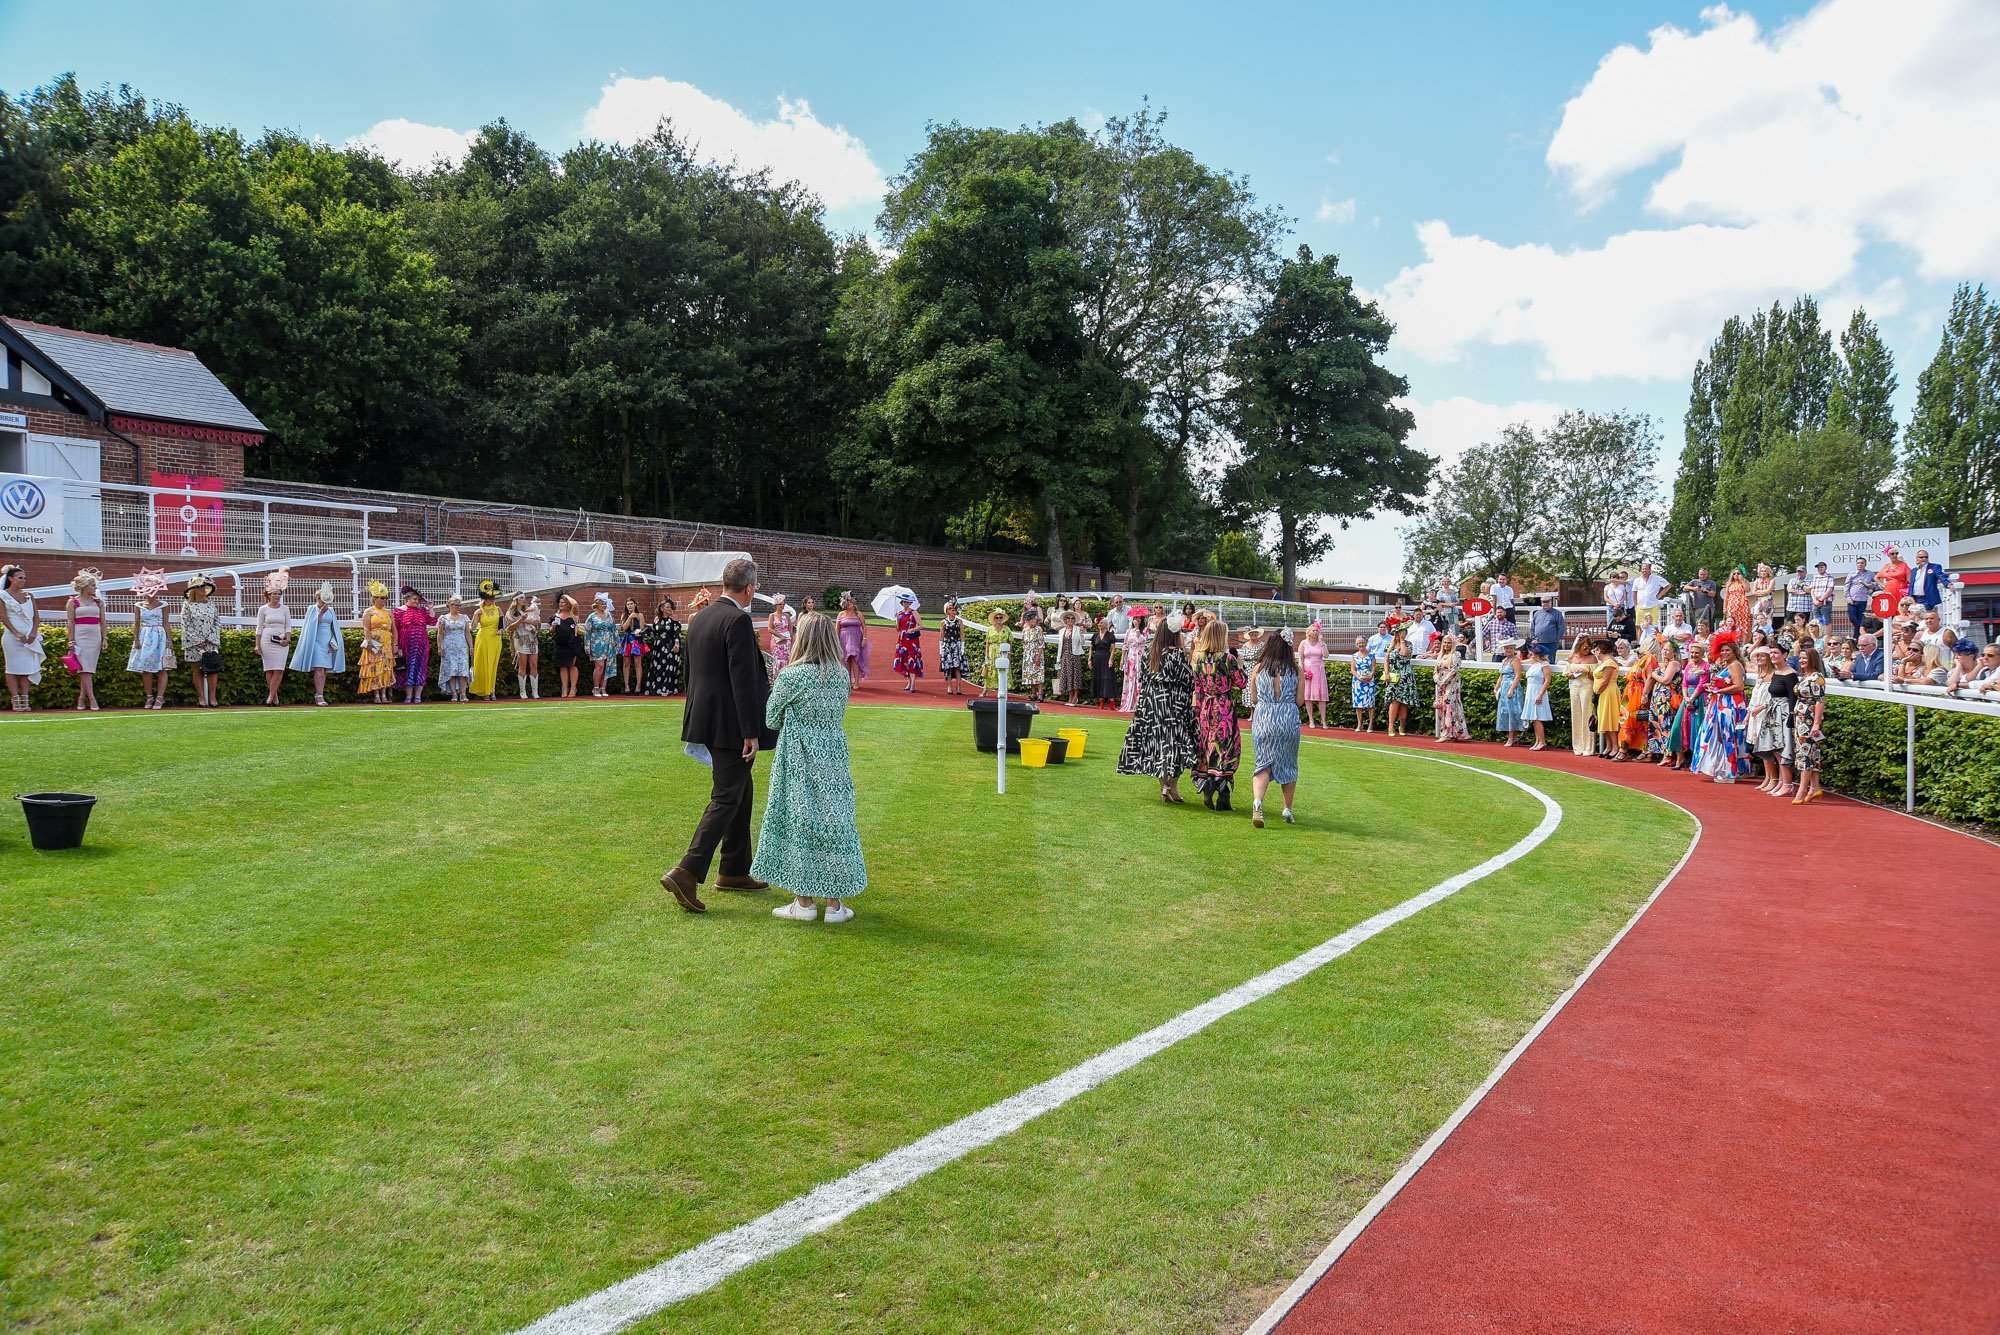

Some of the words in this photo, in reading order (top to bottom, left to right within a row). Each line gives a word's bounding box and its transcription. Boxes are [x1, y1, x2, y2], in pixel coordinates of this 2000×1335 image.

[0, 525, 54, 535] ommercial
[3, 534, 45, 544] Vehicles
[1832, 537, 1941, 552] ADMINISTRATION
[1471, 601, 1483, 612] 4TH
